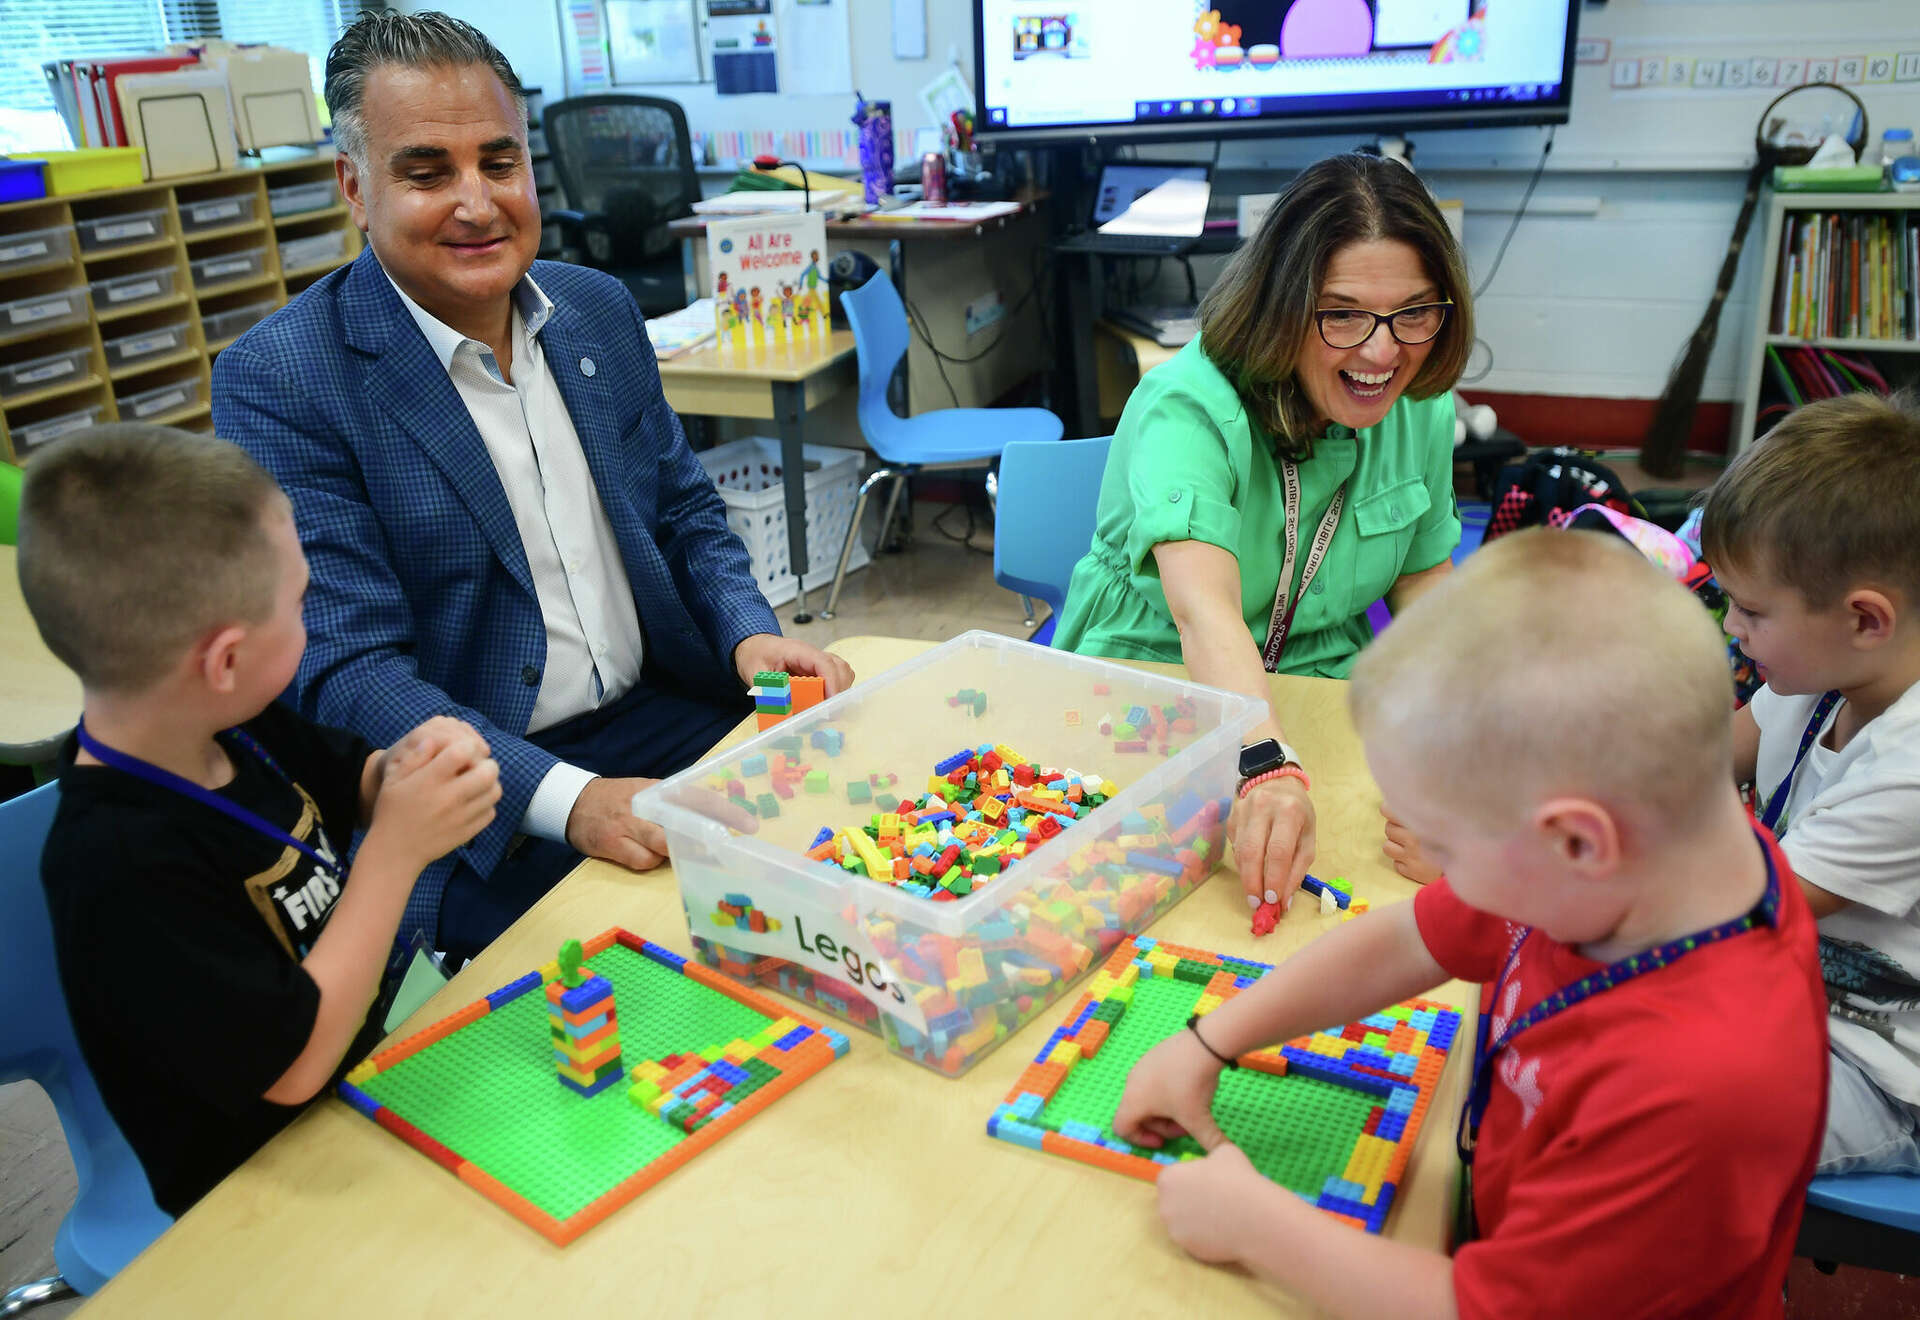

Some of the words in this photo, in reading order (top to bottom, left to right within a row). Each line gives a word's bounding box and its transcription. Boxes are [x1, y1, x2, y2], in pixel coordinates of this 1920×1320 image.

[1645, 61, 1659, 81] 2
[1672, 62, 1685, 82] 3
[1701, 64, 1716, 80] 4
[1731, 63, 1744, 82] 5
[1754, 62, 1769, 81] 6
[1785, 62, 1799, 81] 7
[1814, 63, 1828, 82] 8
[1843, 61, 1857, 78] 9
[1870, 58, 1890, 78] 10
[747, 233, 763, 250] All
[768, 233, 792, 248] Are
[739, 250, 804, 271] Welcome
[1264, 623, 1287, 670] SCHOOLS
